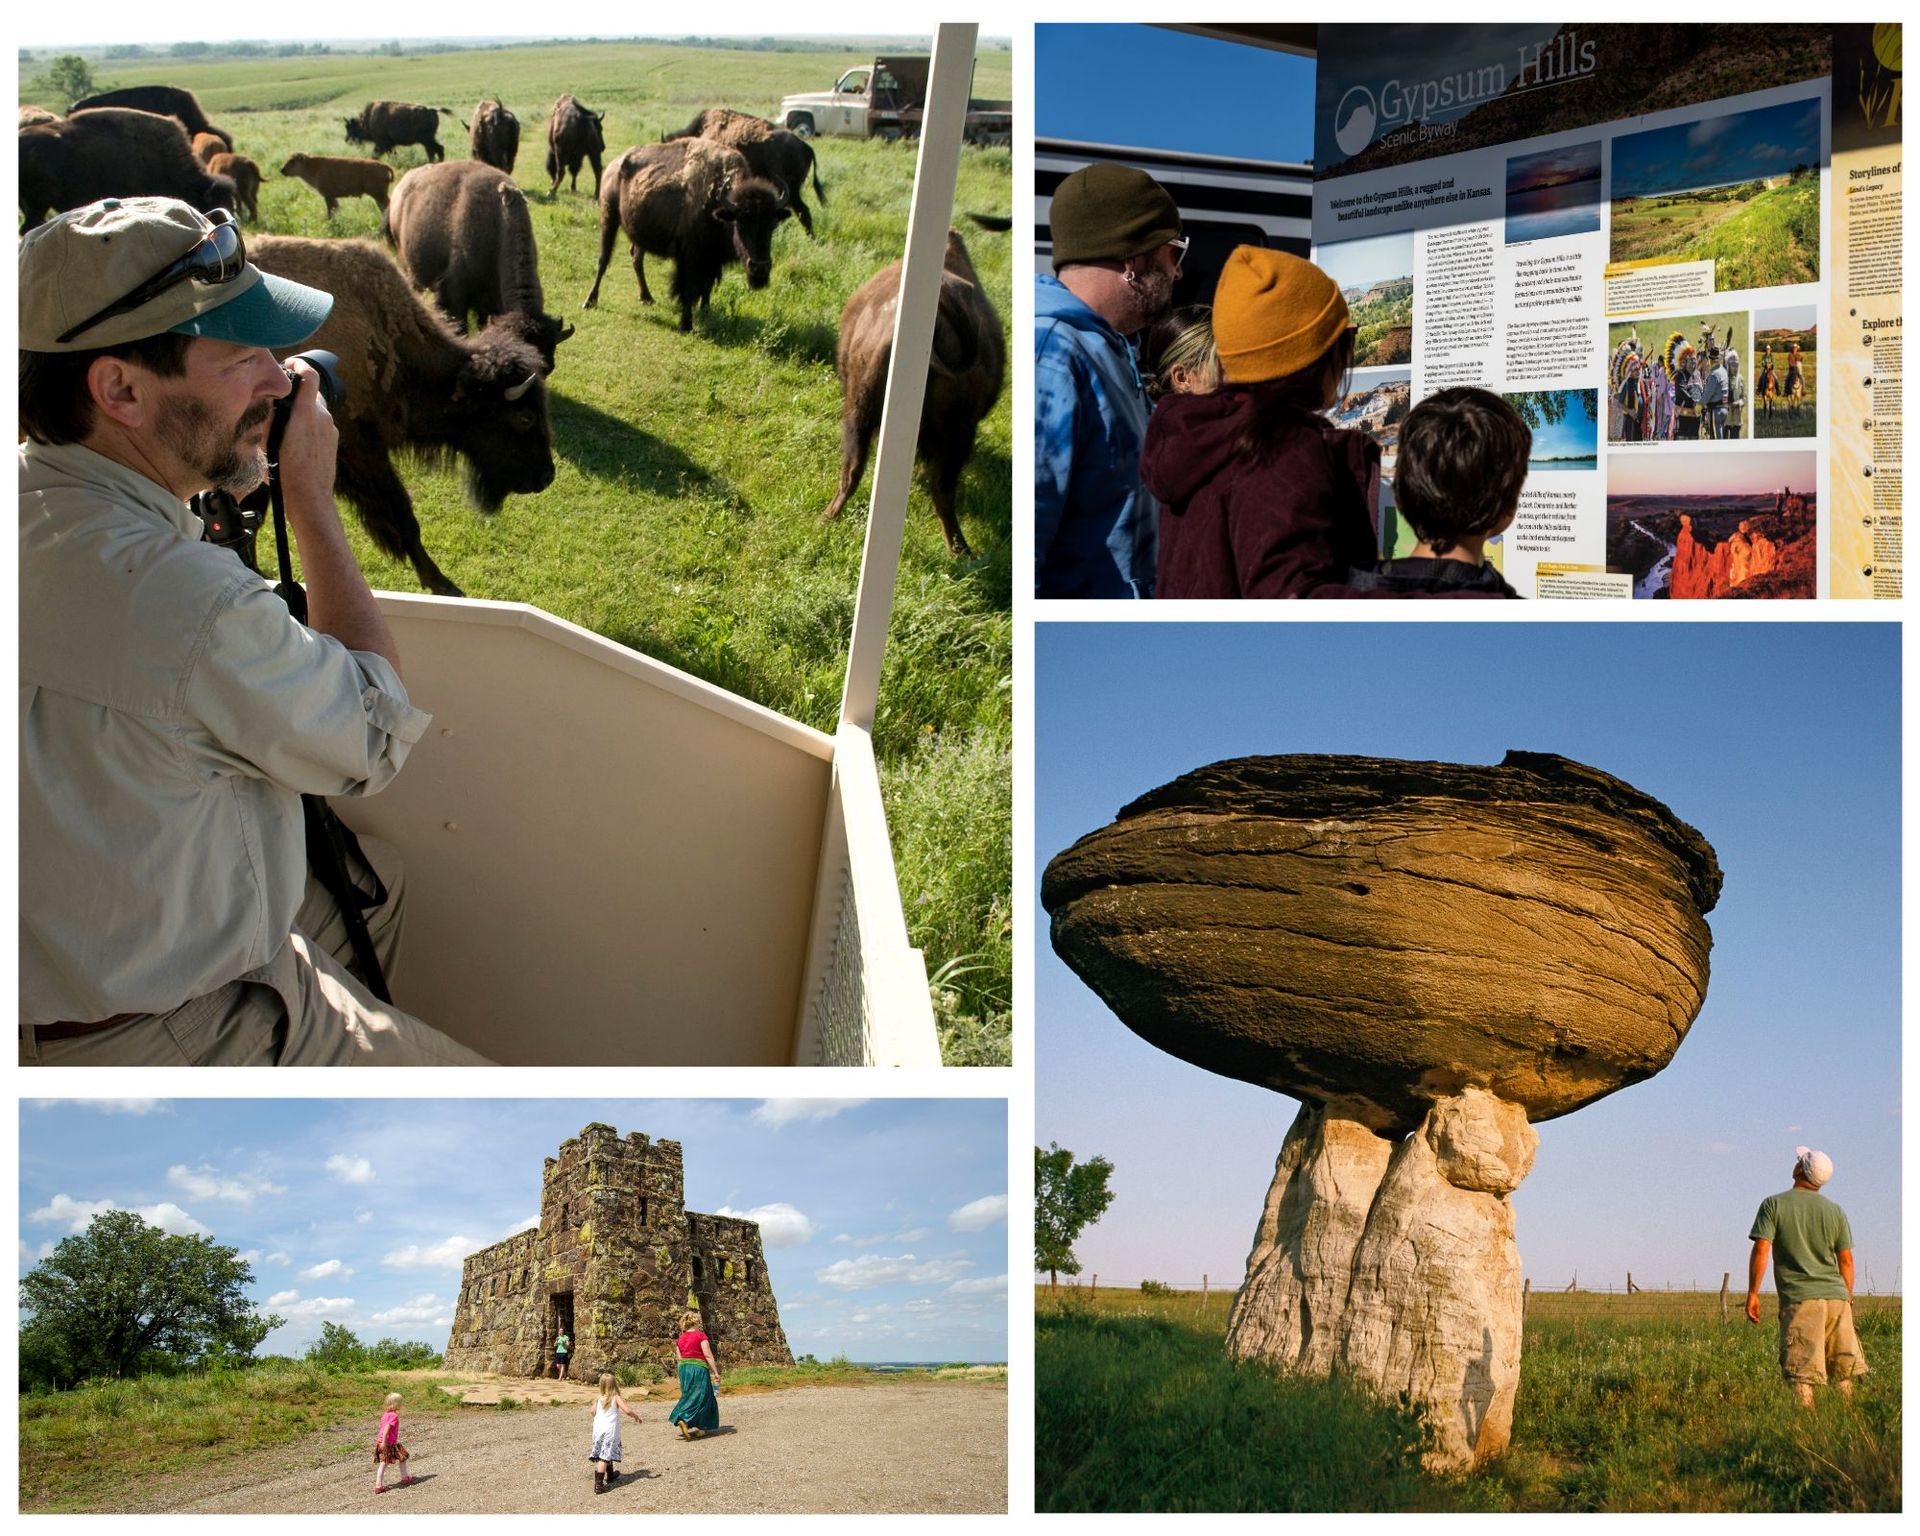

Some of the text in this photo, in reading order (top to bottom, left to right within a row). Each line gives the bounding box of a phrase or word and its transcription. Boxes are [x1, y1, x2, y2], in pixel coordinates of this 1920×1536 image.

[1380, 31, 1596, 125] Gypsum Hills
[1380, 120, 1459, 150] Scenic Byway
[1849, 162, 1902, 180] Storylines of
[1330, 197, 1355, 209] Welcome
[1356, 196, 1362, 205] to
[1363, 193, 1373, 204] the
[1373, 190, 1397, 204] Gypsum
[1419, 181, 1442, 195] rugged
[1442, 177, 1454, 188] and
[1866, 183, 1884, 193] Legacy
[1338, 186, 1493, 222] beautiful landscape unlike anywhere else in Kansas.
[1862, 318, 1895, 331] Explore
